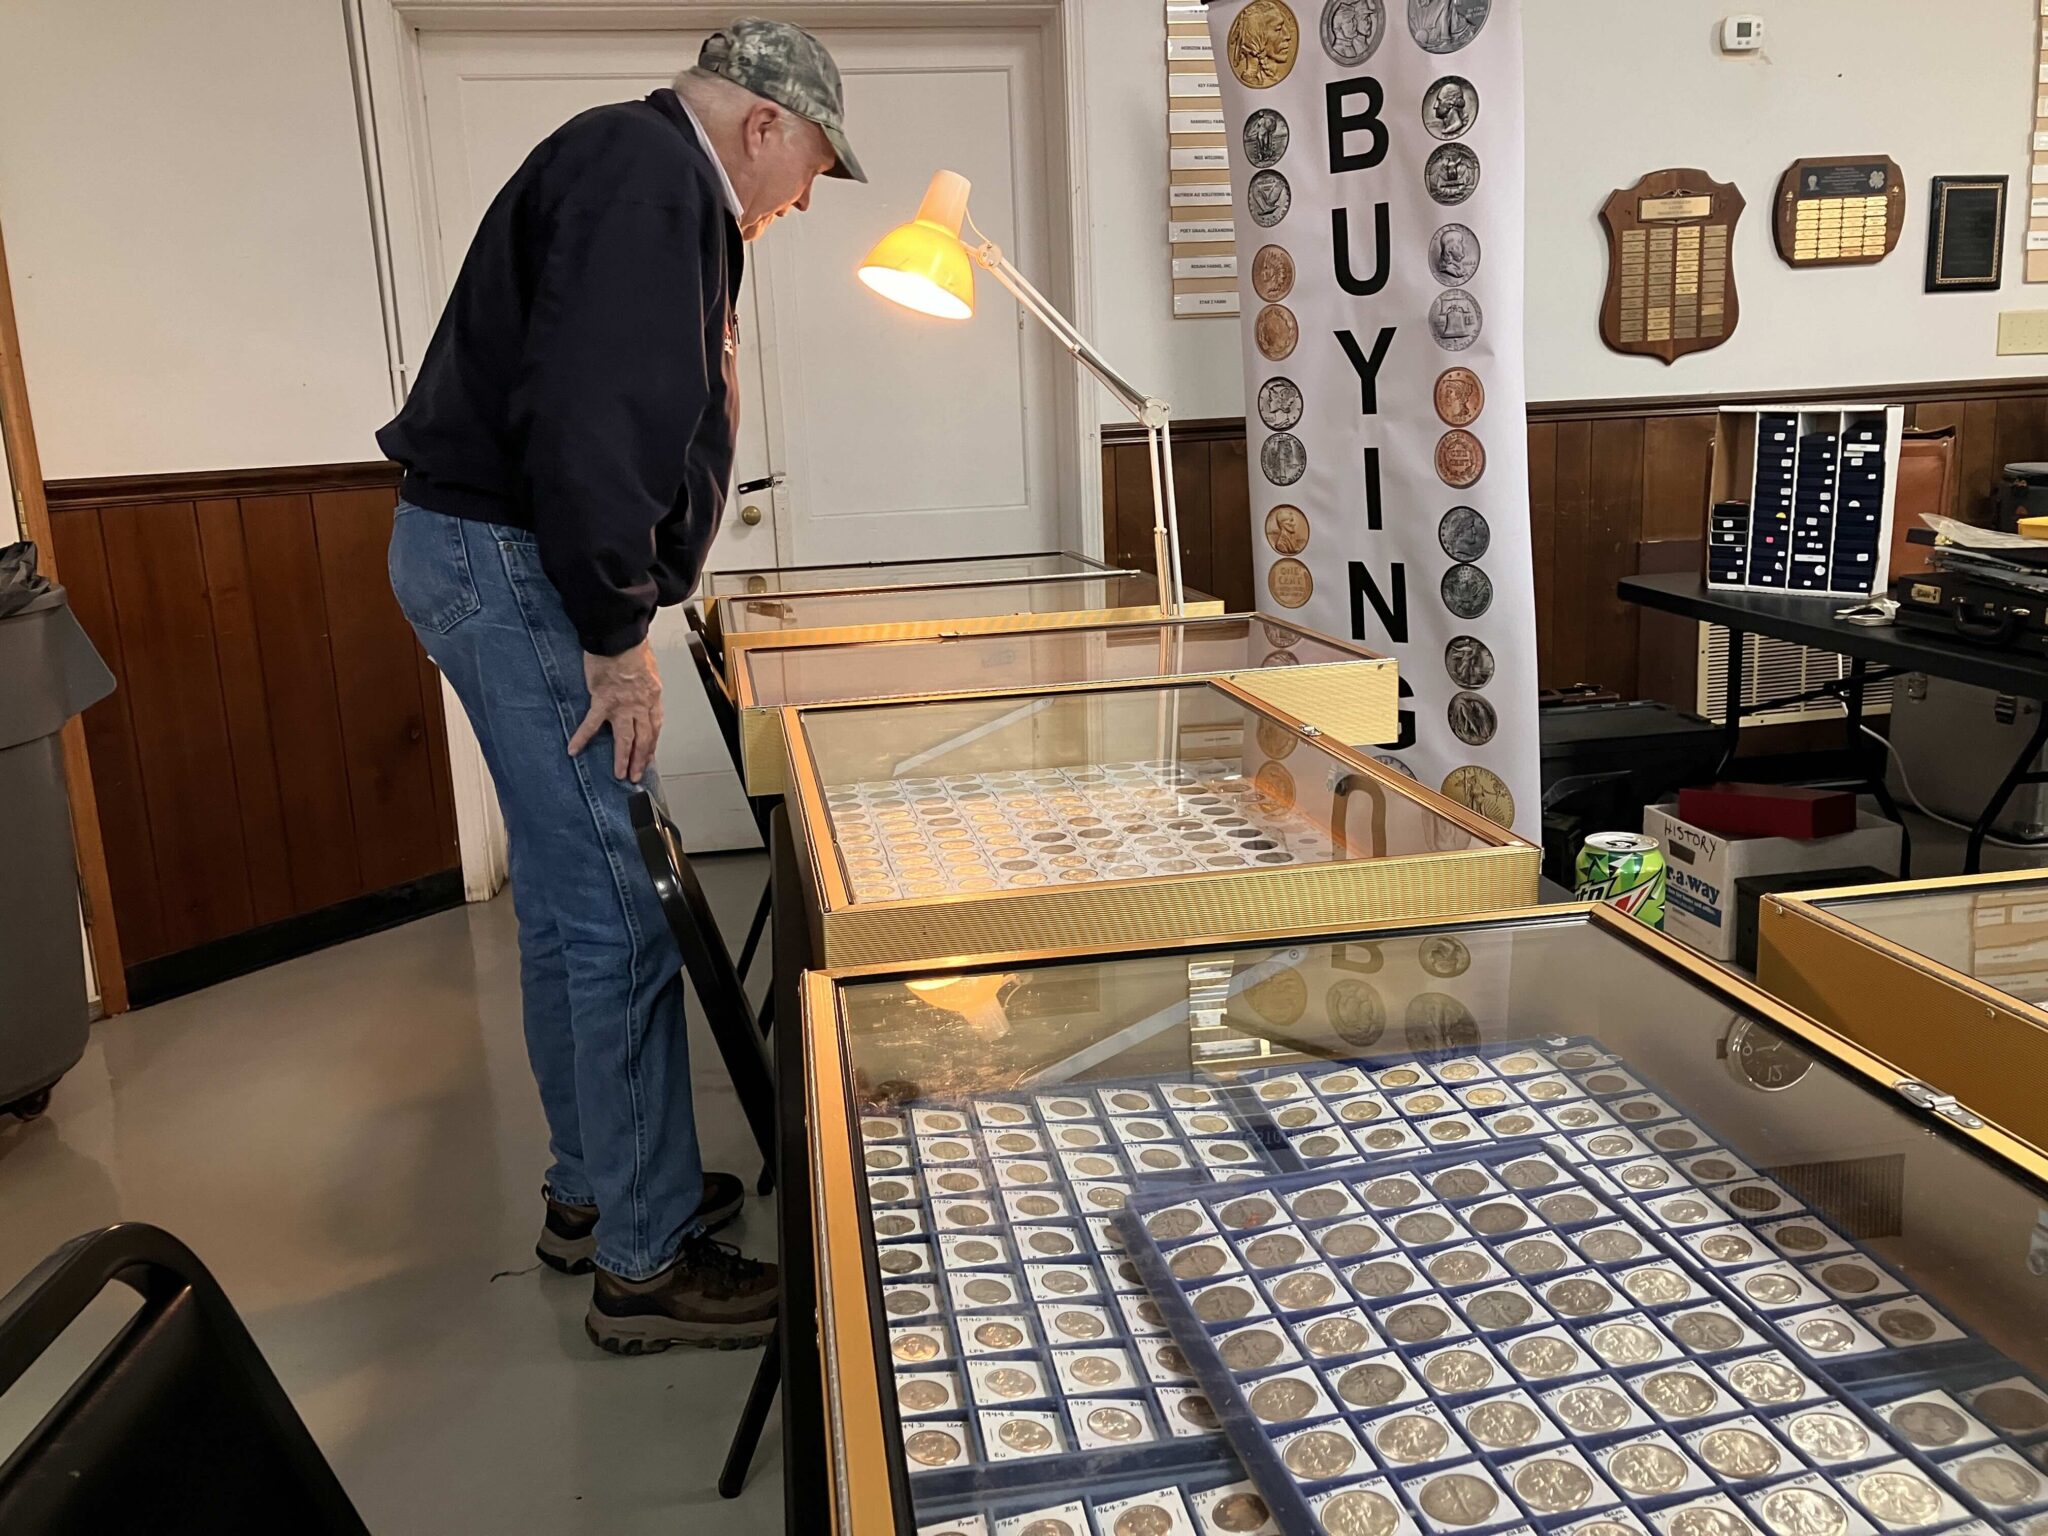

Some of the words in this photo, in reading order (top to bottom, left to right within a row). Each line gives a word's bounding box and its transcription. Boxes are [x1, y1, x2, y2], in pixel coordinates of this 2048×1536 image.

[1279, 566, 1301, 576] ONE
[1277, 575, 1303, 585] CENT
[1664, 819, 1717, 862] HISTORY
